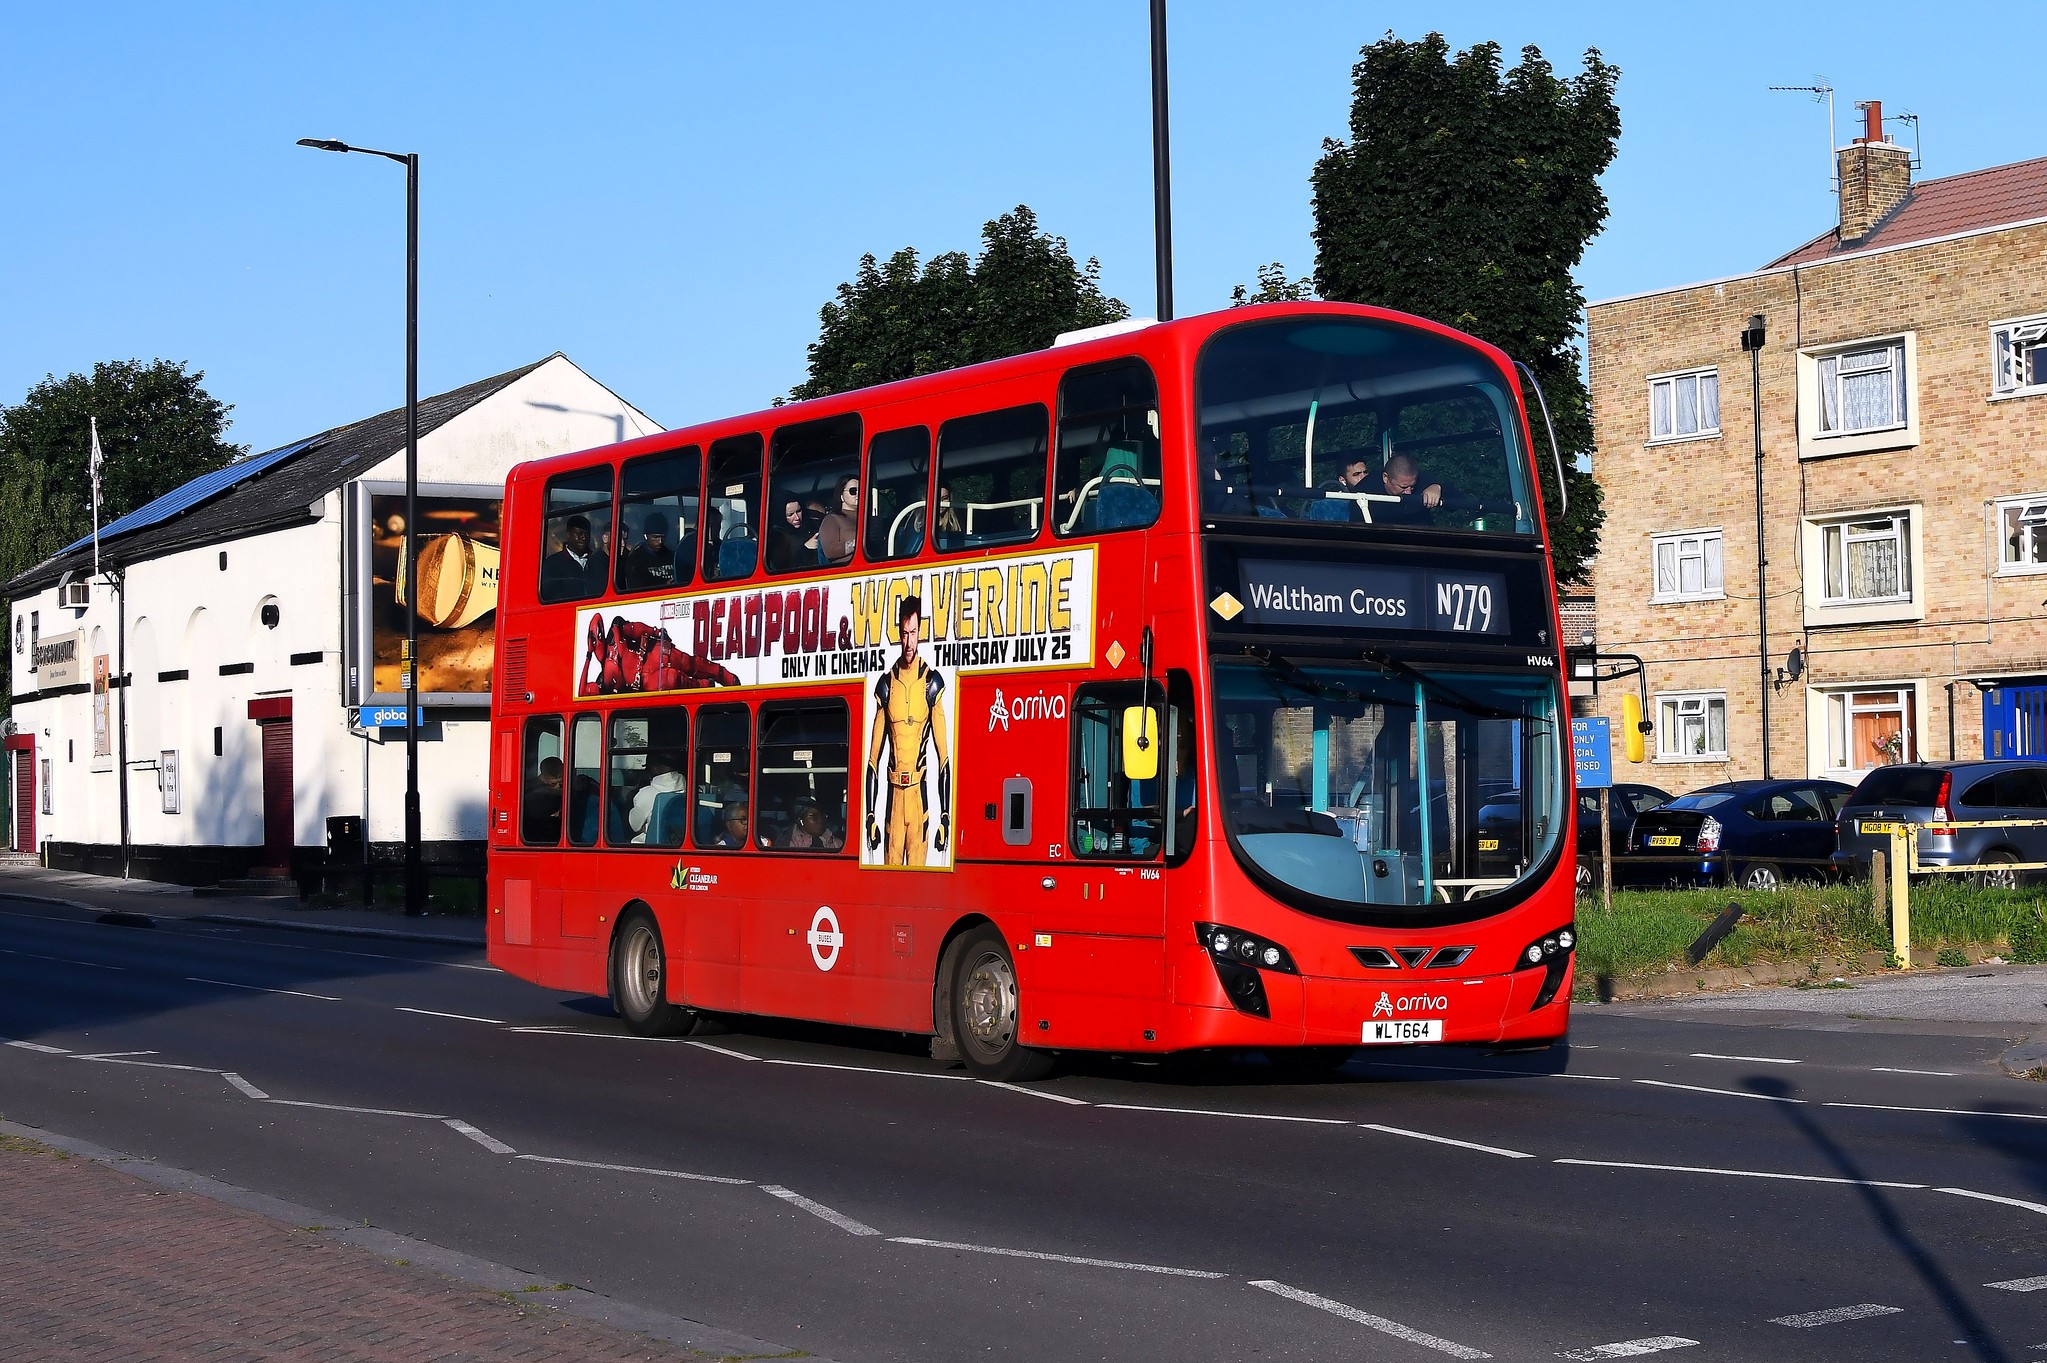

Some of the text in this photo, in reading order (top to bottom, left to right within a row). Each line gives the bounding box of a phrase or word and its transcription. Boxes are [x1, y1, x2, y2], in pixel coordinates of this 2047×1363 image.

[692, 586, 836, 661] DEADPOOL
[851, 557, 1074, 648] WOLVERINE
[1249, 582, 1492, 632] Waltham Cross N279
[934, 635, 1071, 667] THURSDAY JULY 25
[781, 648, 886, 679] ONLY IN CINEMAS
[1526, 655, 1554, 667] HV64
[1012, 689, 1065, 721] arriva
[374, 710, 407, 725] globa
[1571, 722, 1588, 732] FOR
[1573, 735, 1595, 744] ONLY
[1883, 823, 1892, 832] YF
[1049, 843, 1062, 858] EC
[1140, 868, 1160, 880] HV64
[818, 934, 832, 943] BUSES
[1396, 992, 1448, 1011] arriva
[1375, 1022, 1429, 1039] WLT664
